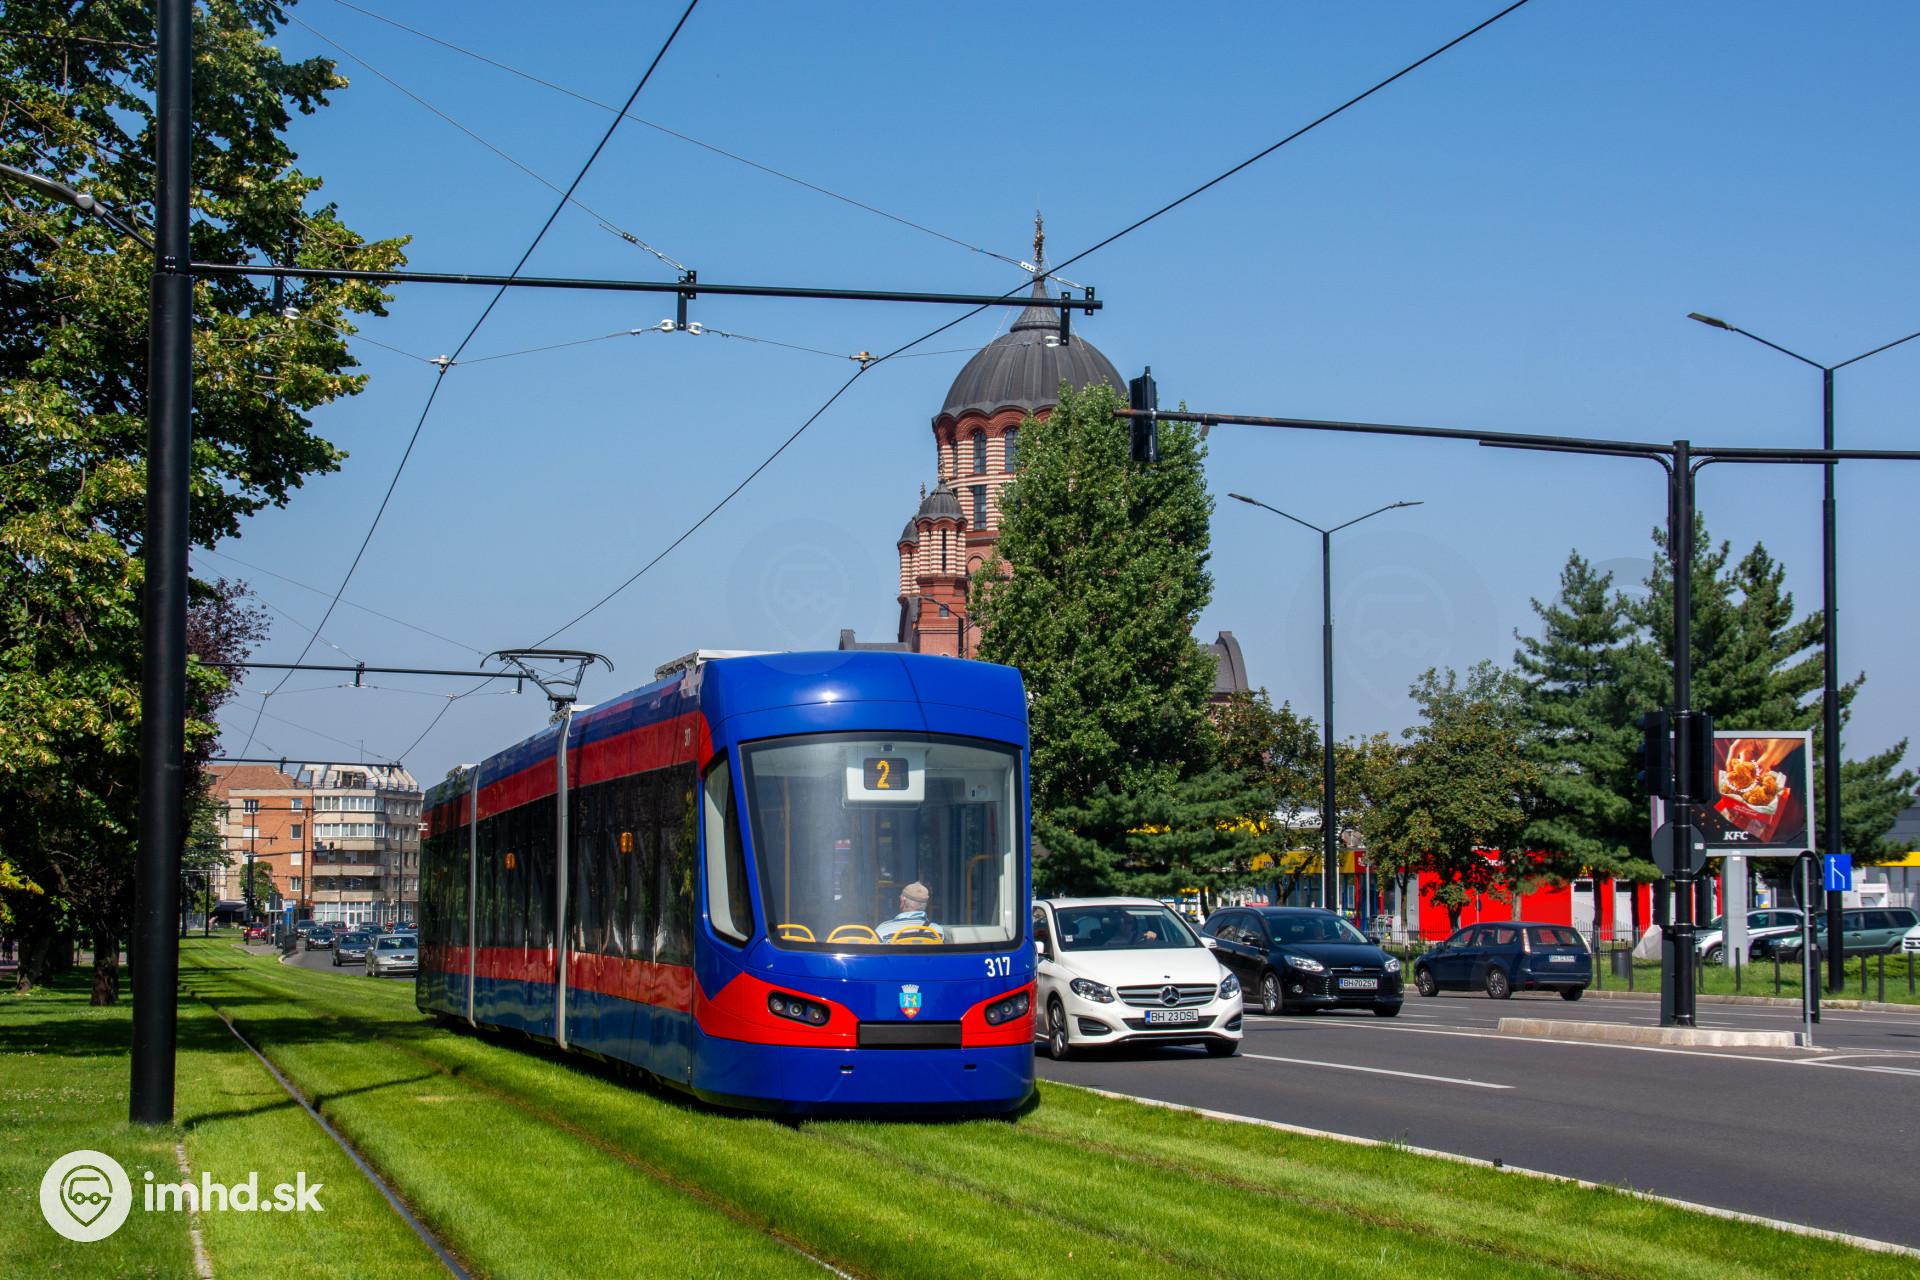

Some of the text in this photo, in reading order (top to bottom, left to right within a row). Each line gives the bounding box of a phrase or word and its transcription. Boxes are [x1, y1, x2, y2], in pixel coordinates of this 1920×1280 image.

[876, 760, 890, 789] 2
[1723, 831, 1749, 840] KFC
[984, 956, 1010, 978] 317
[1151, 1012, 1165, 1021] BH
